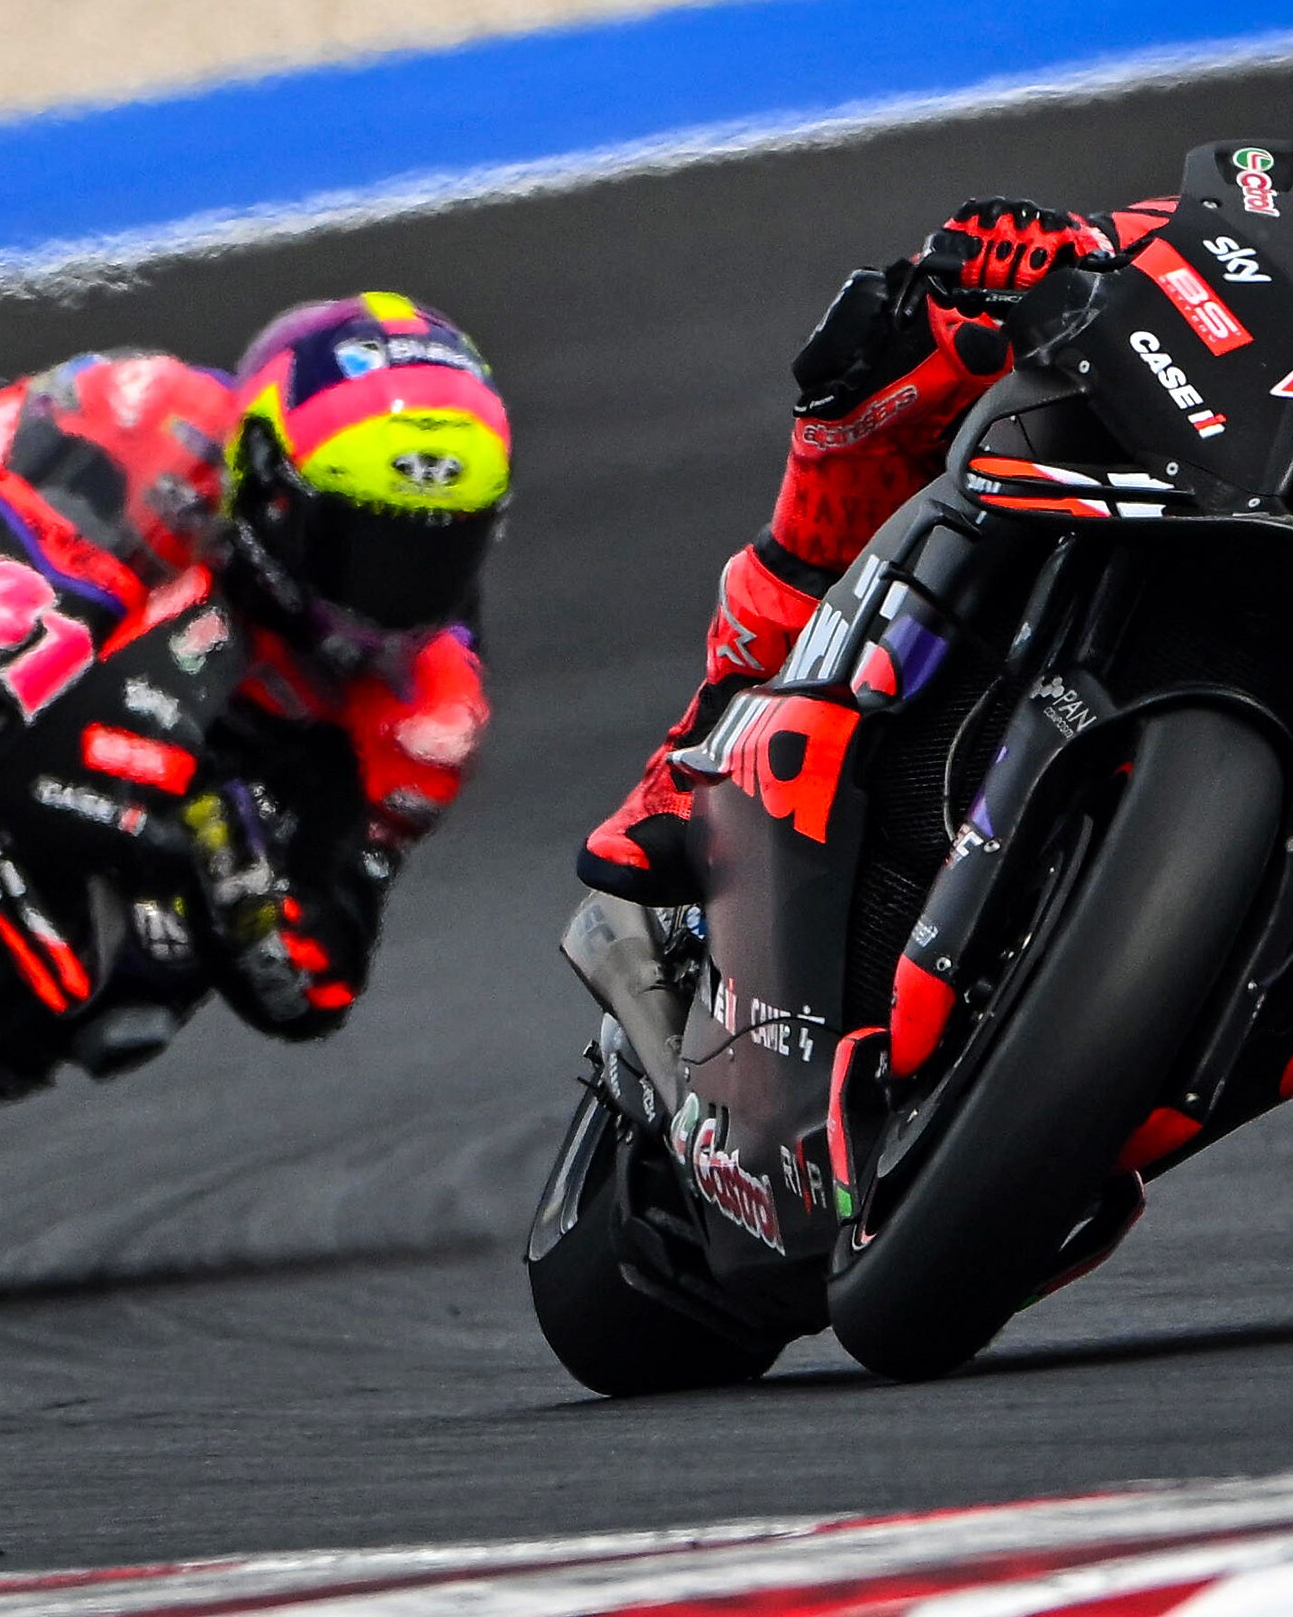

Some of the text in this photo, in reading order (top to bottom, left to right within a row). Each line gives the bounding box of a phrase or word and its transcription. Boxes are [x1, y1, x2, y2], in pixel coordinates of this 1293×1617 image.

[1202, 236, 1273, 282] sky
[1129, 330, 1205, 410] CASE
[1052, 687, 1097, 732] PAN
